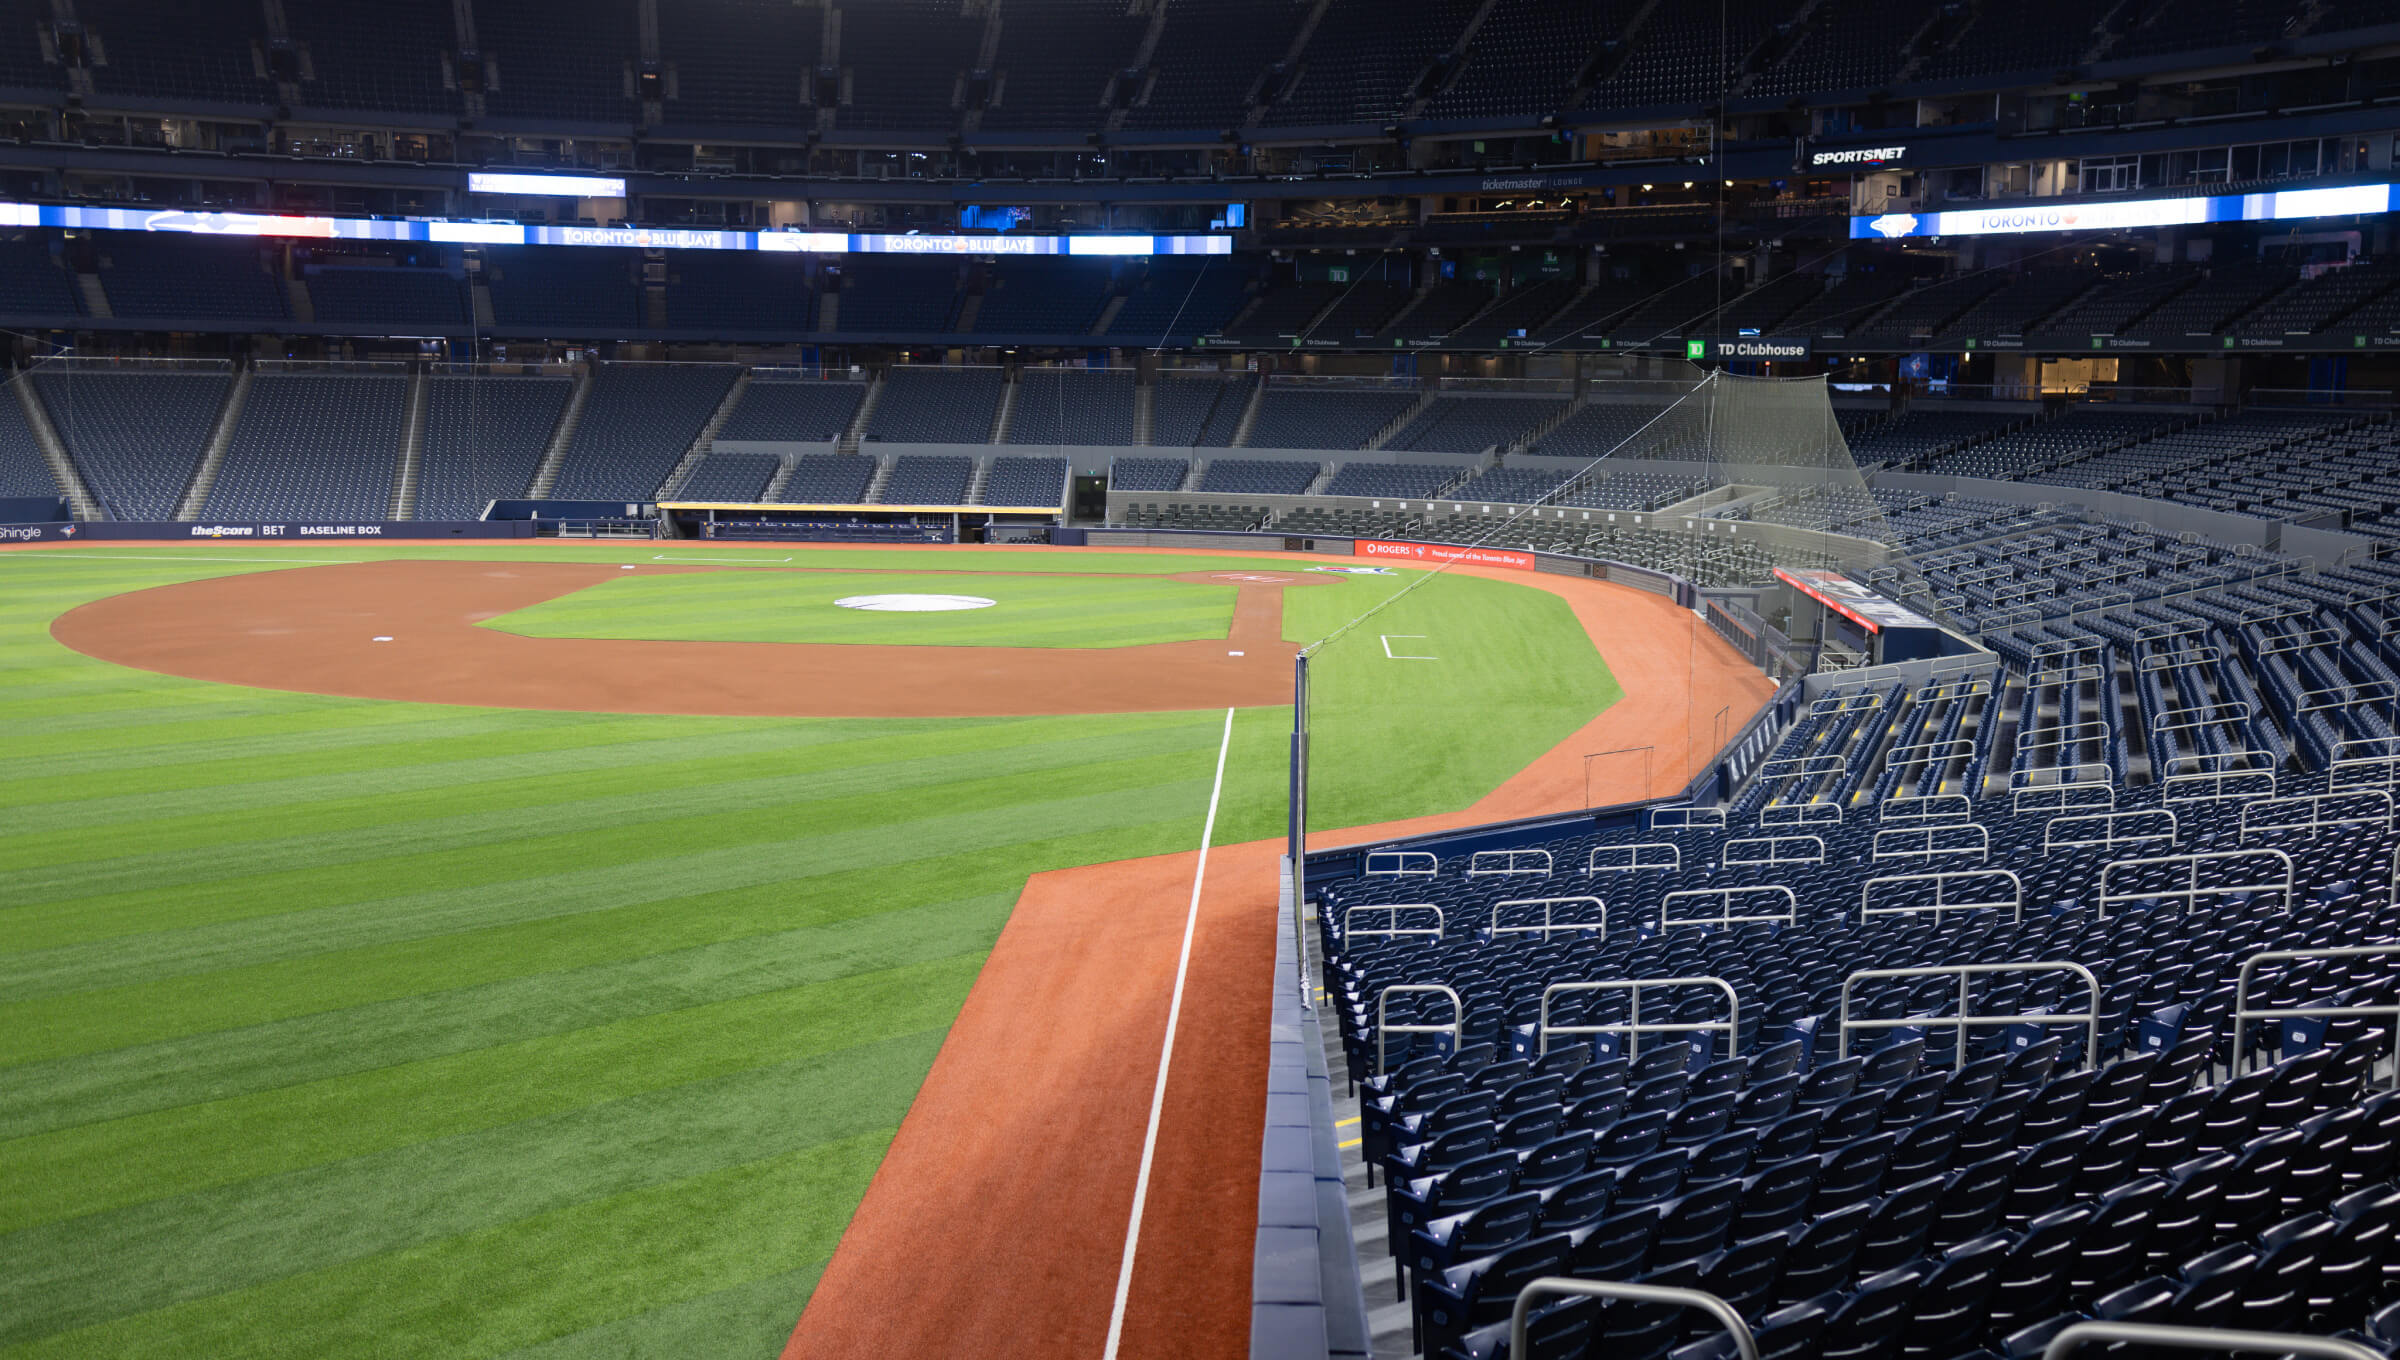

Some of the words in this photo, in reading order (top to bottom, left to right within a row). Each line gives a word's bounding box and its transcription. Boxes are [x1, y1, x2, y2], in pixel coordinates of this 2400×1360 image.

[1812, 146, 1907, 165] SPORTSNET
[1482, 178, 1544, 191] ticketmaster
[1553, 177, 1583, 187] LOUNGE
[1980, 212, 2060, 229] TORONTO
[564, 229, 634, 245] TORONTO
[650, 231, 687, 246] BLUE
[687, 232, 721, 247] JAYS
[886, 238, 953, 251] TORONTO
[970, 239, 1003, 251] BLUE
[1003, 239, 1034, 252] JAYS
[1689, 344, 1703, 355] TD
[1718, 344, 1735, 355] TD
[1737, 343, 1804, 356] Clubhouse
[191, 525, 253, 536] theScore
[263, 525, 285, 536] BET
[300, 526, 356, 535] BASELINE
[358, 526, 382, 535] BOX
[1377, 544, 1410, 555] ROGERS
